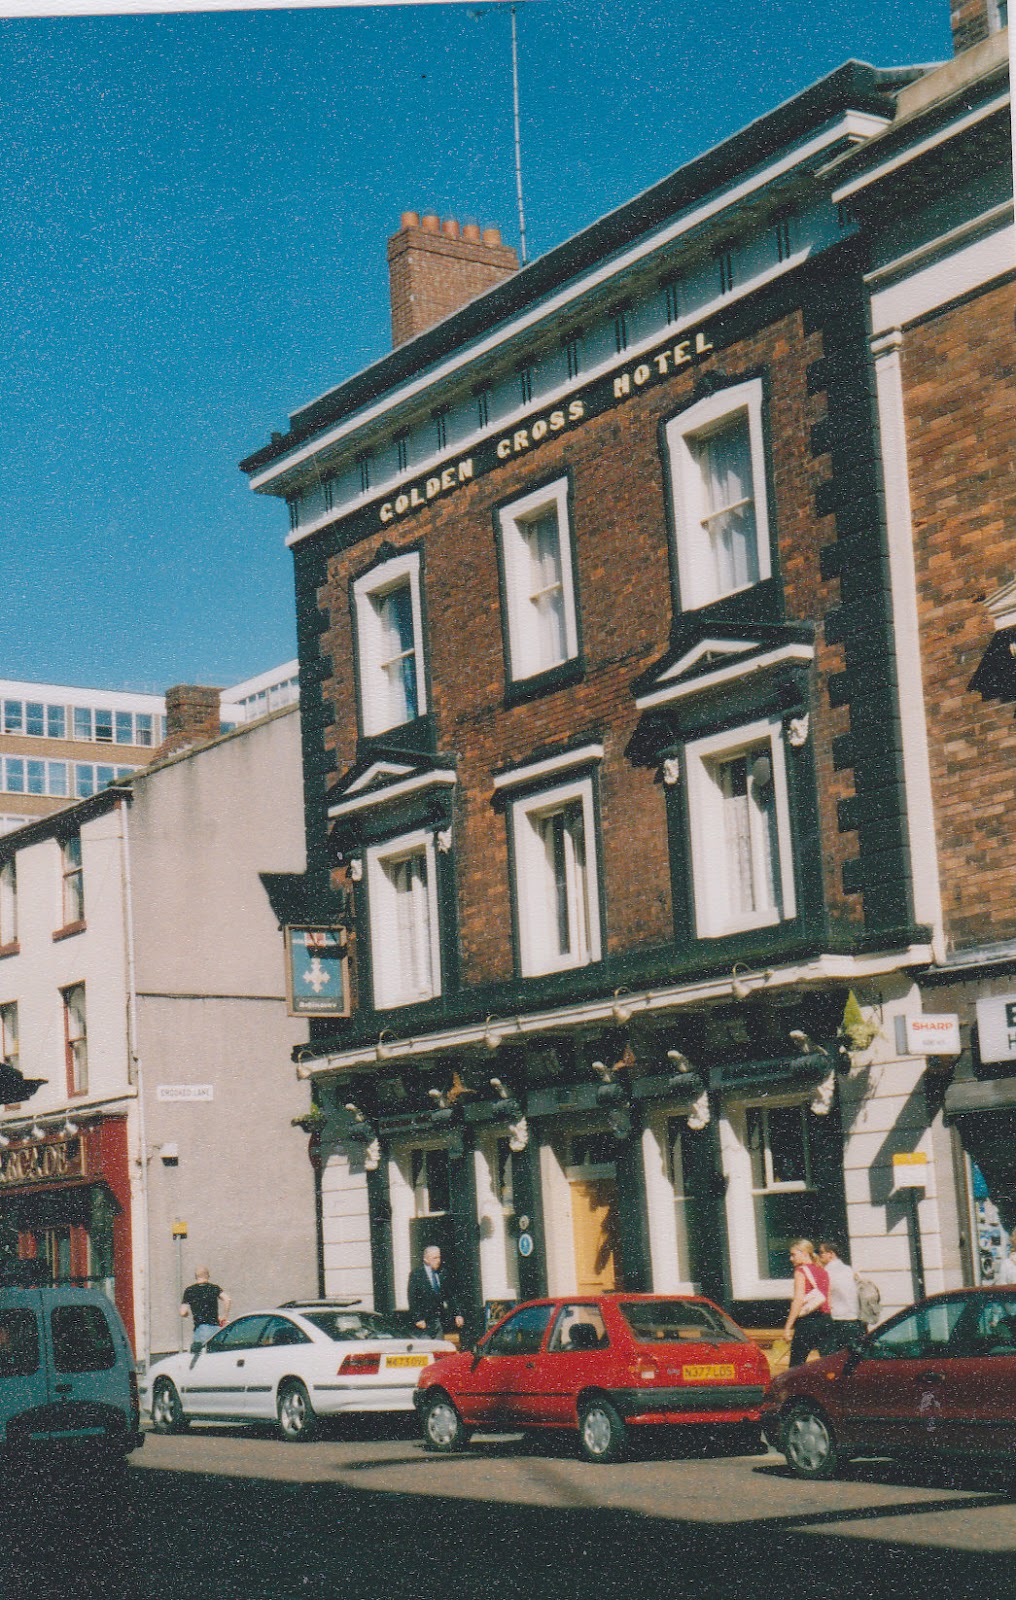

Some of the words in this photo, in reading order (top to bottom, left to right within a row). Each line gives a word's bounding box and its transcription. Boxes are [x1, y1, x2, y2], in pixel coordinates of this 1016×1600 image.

[379, 458, 475, 523] GOLDEN
[497, 400, 585, 459] CROSS
[613, 332, 713, 399] HOTEL
[911, 1021, 953, 1031] SHARP
